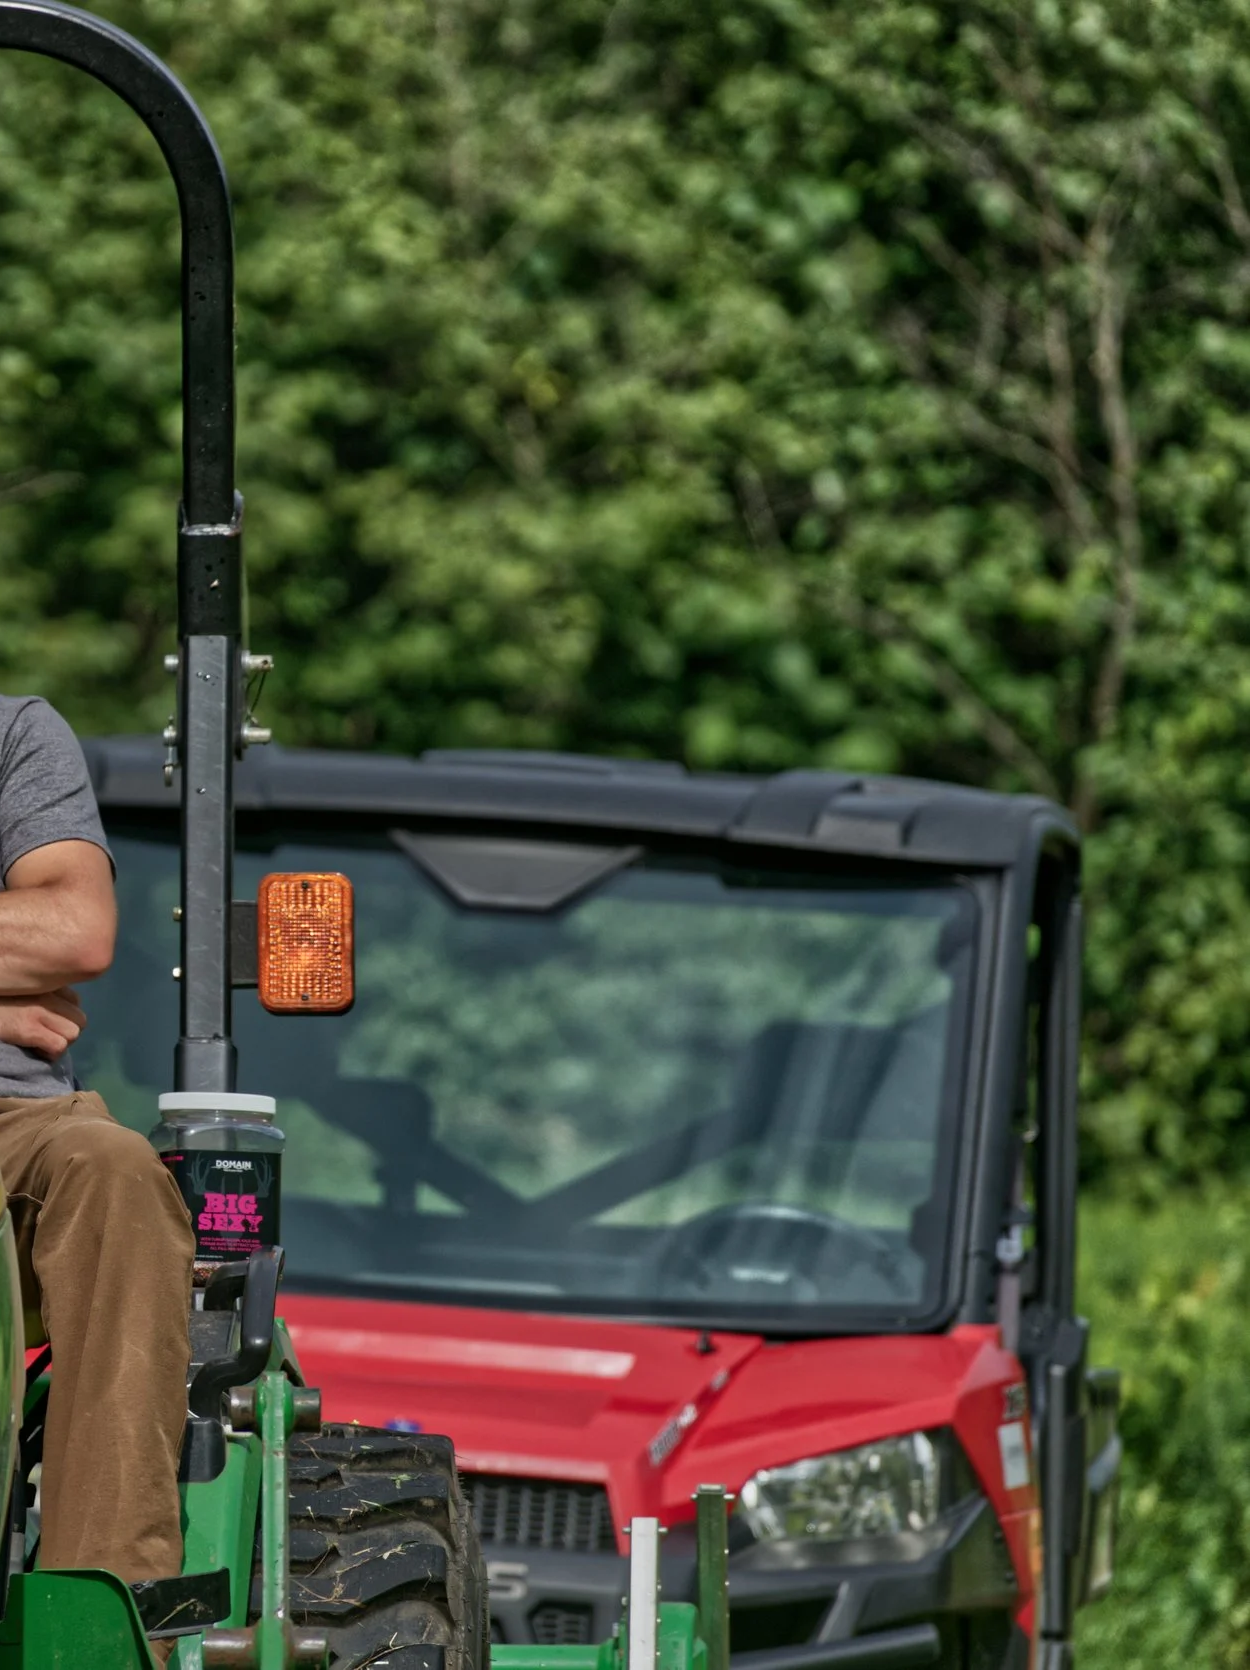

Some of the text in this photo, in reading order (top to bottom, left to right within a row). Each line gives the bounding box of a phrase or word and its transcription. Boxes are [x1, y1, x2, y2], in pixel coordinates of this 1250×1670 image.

[215, 1160, 252, 1169] DOMAIN
[203, 1192, 258, 1214] BIG
[198, 1213, 263, 1232] SEXY
